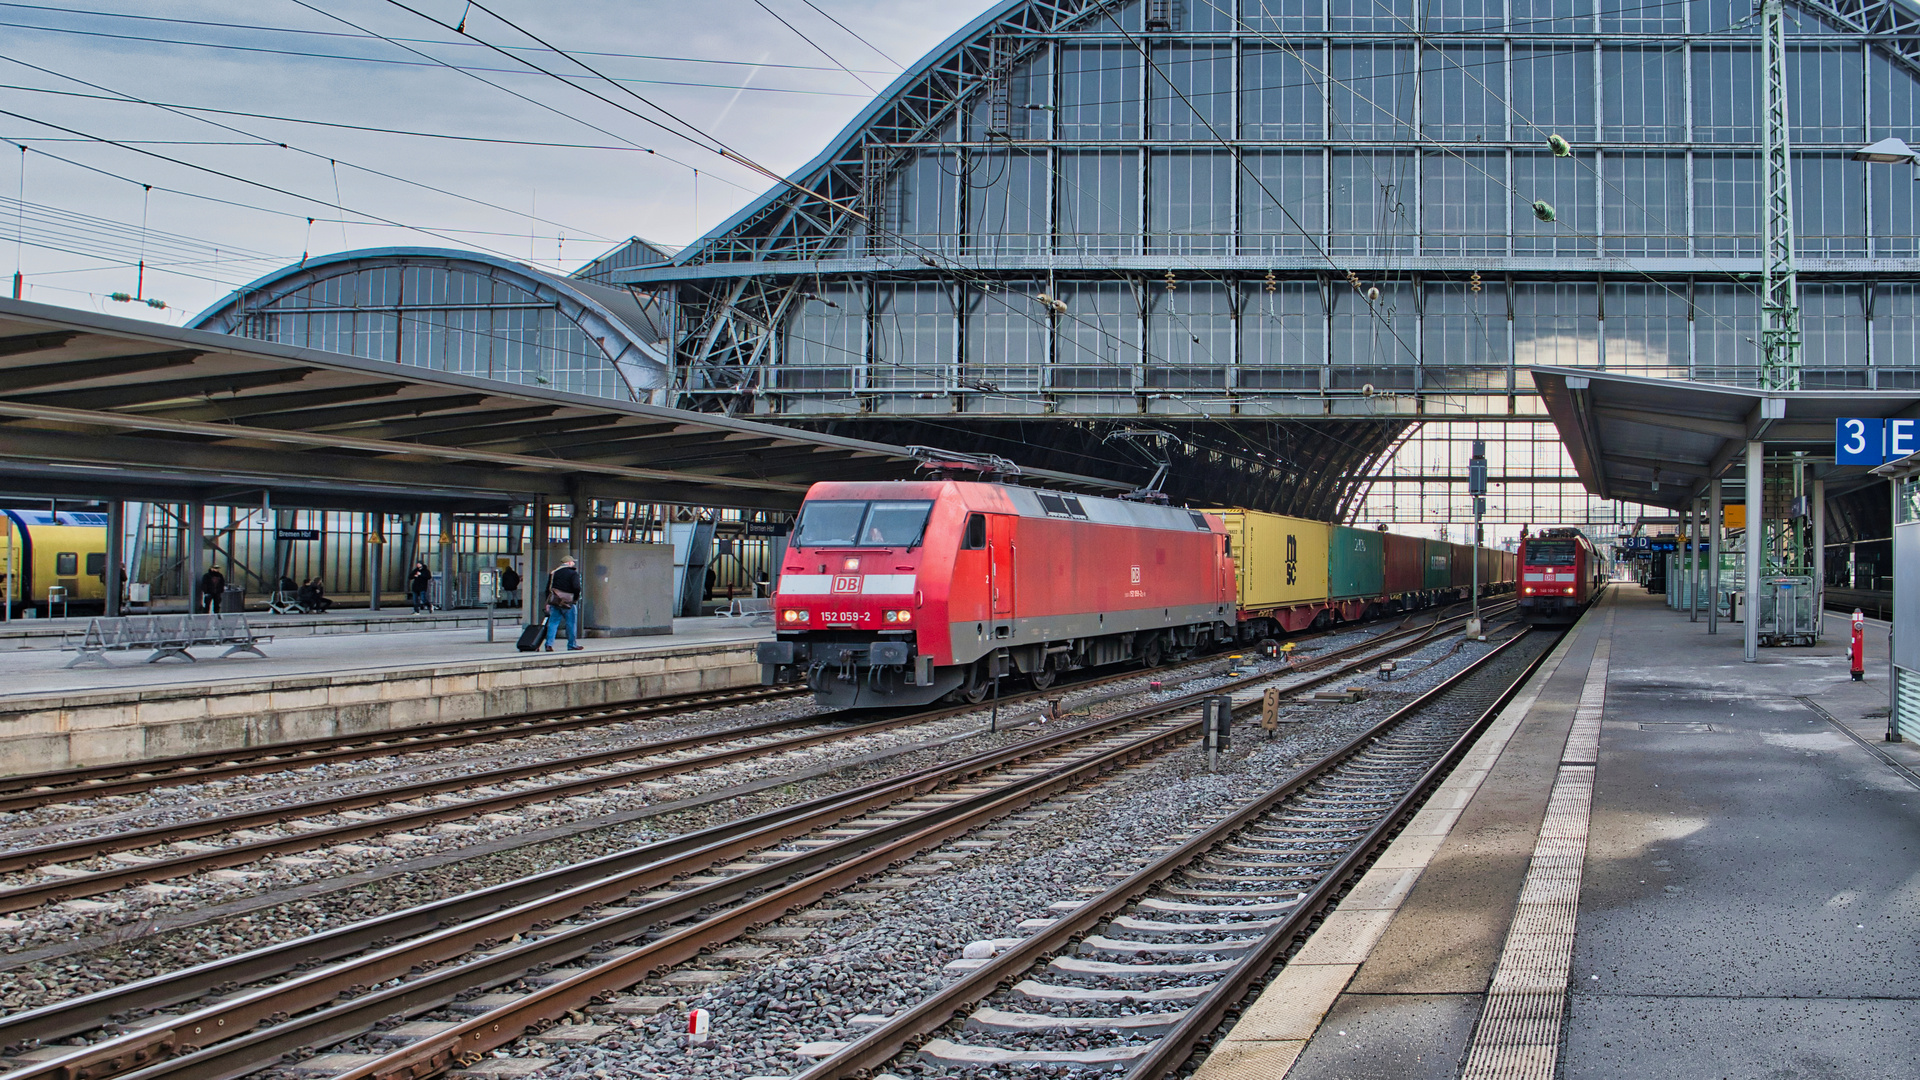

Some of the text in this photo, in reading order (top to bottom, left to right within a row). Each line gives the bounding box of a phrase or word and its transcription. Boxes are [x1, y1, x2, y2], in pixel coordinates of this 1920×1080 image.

[1843, 419, 1915, 455] 3 E
[278, 530, 300, 538] Bremen
[1628, 537, 1635, 547] 3
[1639, 537, 1647, 547] D
[836, 577, 858, 591] DB
[820, 611, 871, 622] 152 059-2
[1268, 692, 1274, 706] 5
[1266, 710, 1274, 724] 2
